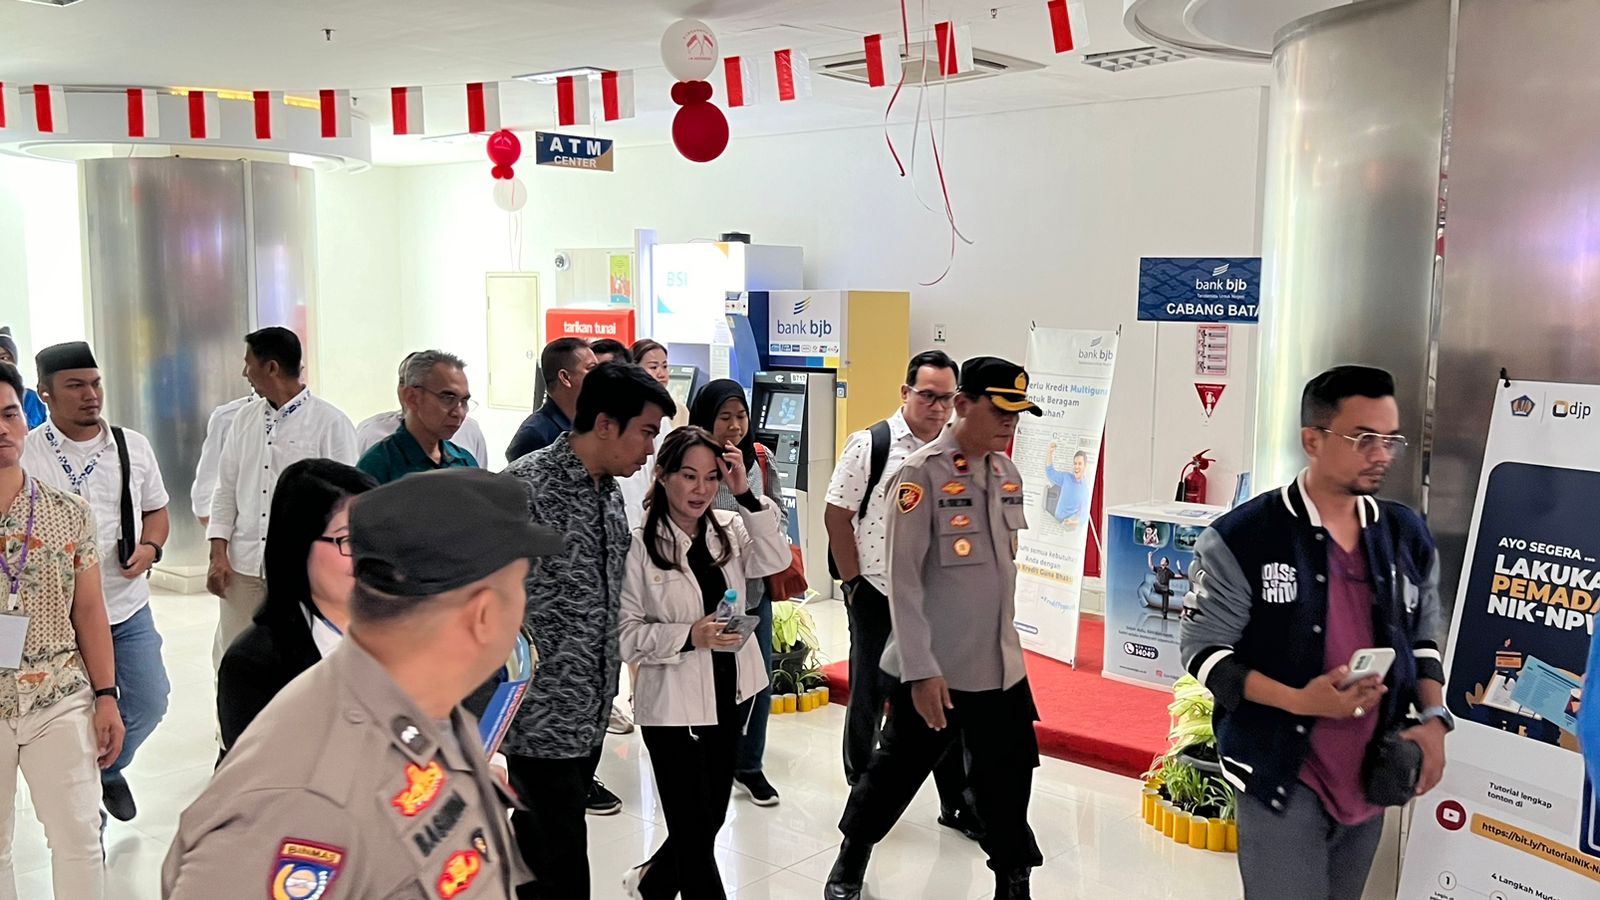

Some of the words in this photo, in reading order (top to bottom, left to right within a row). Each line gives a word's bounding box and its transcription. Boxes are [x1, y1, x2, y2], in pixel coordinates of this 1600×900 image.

[549, 136, 601, 156] ATM
[554, 155, 597, 168] CENTER
[667, 271, 688, 287] BSI
[1195, 278, 1223, 290] bank
[1226, 278, 1247, 293] bjb
[1166, 303, 1224, 315] CABANG
[563, 321, 593, 334] tarikan
[594, 322, 616, 335] tunai
[777, 319, 806, 334] bank
[810, 319, 832, 338] bjb
[1078, 348, 1098, 359] bank
[1099, 349, 1113, 361] bjb
[1029, 381, 1044, 390] erlu
[1045, 382, 1068, 392] Kredit
[1027, 394, 1045, 403] ntuk
[1047, 395, 1080, 407] Beragam
[1569, 401, 1591, 419] djp
[782, 497, 796, 509] TM
[1498, 537, 1527, 550] AYO
[1529, 541, 1581, 560] SEGERA
[1487, 791, 1513, 807] tonton
[1515, 799, 1523, 808] di
[1489, 782, 1519, 798] Tutorial
[1520, 790, 1552, 809] lengkap
[1491, 872, 1498, 880] 4
[1498, 875, 1534, 894] Langkah
